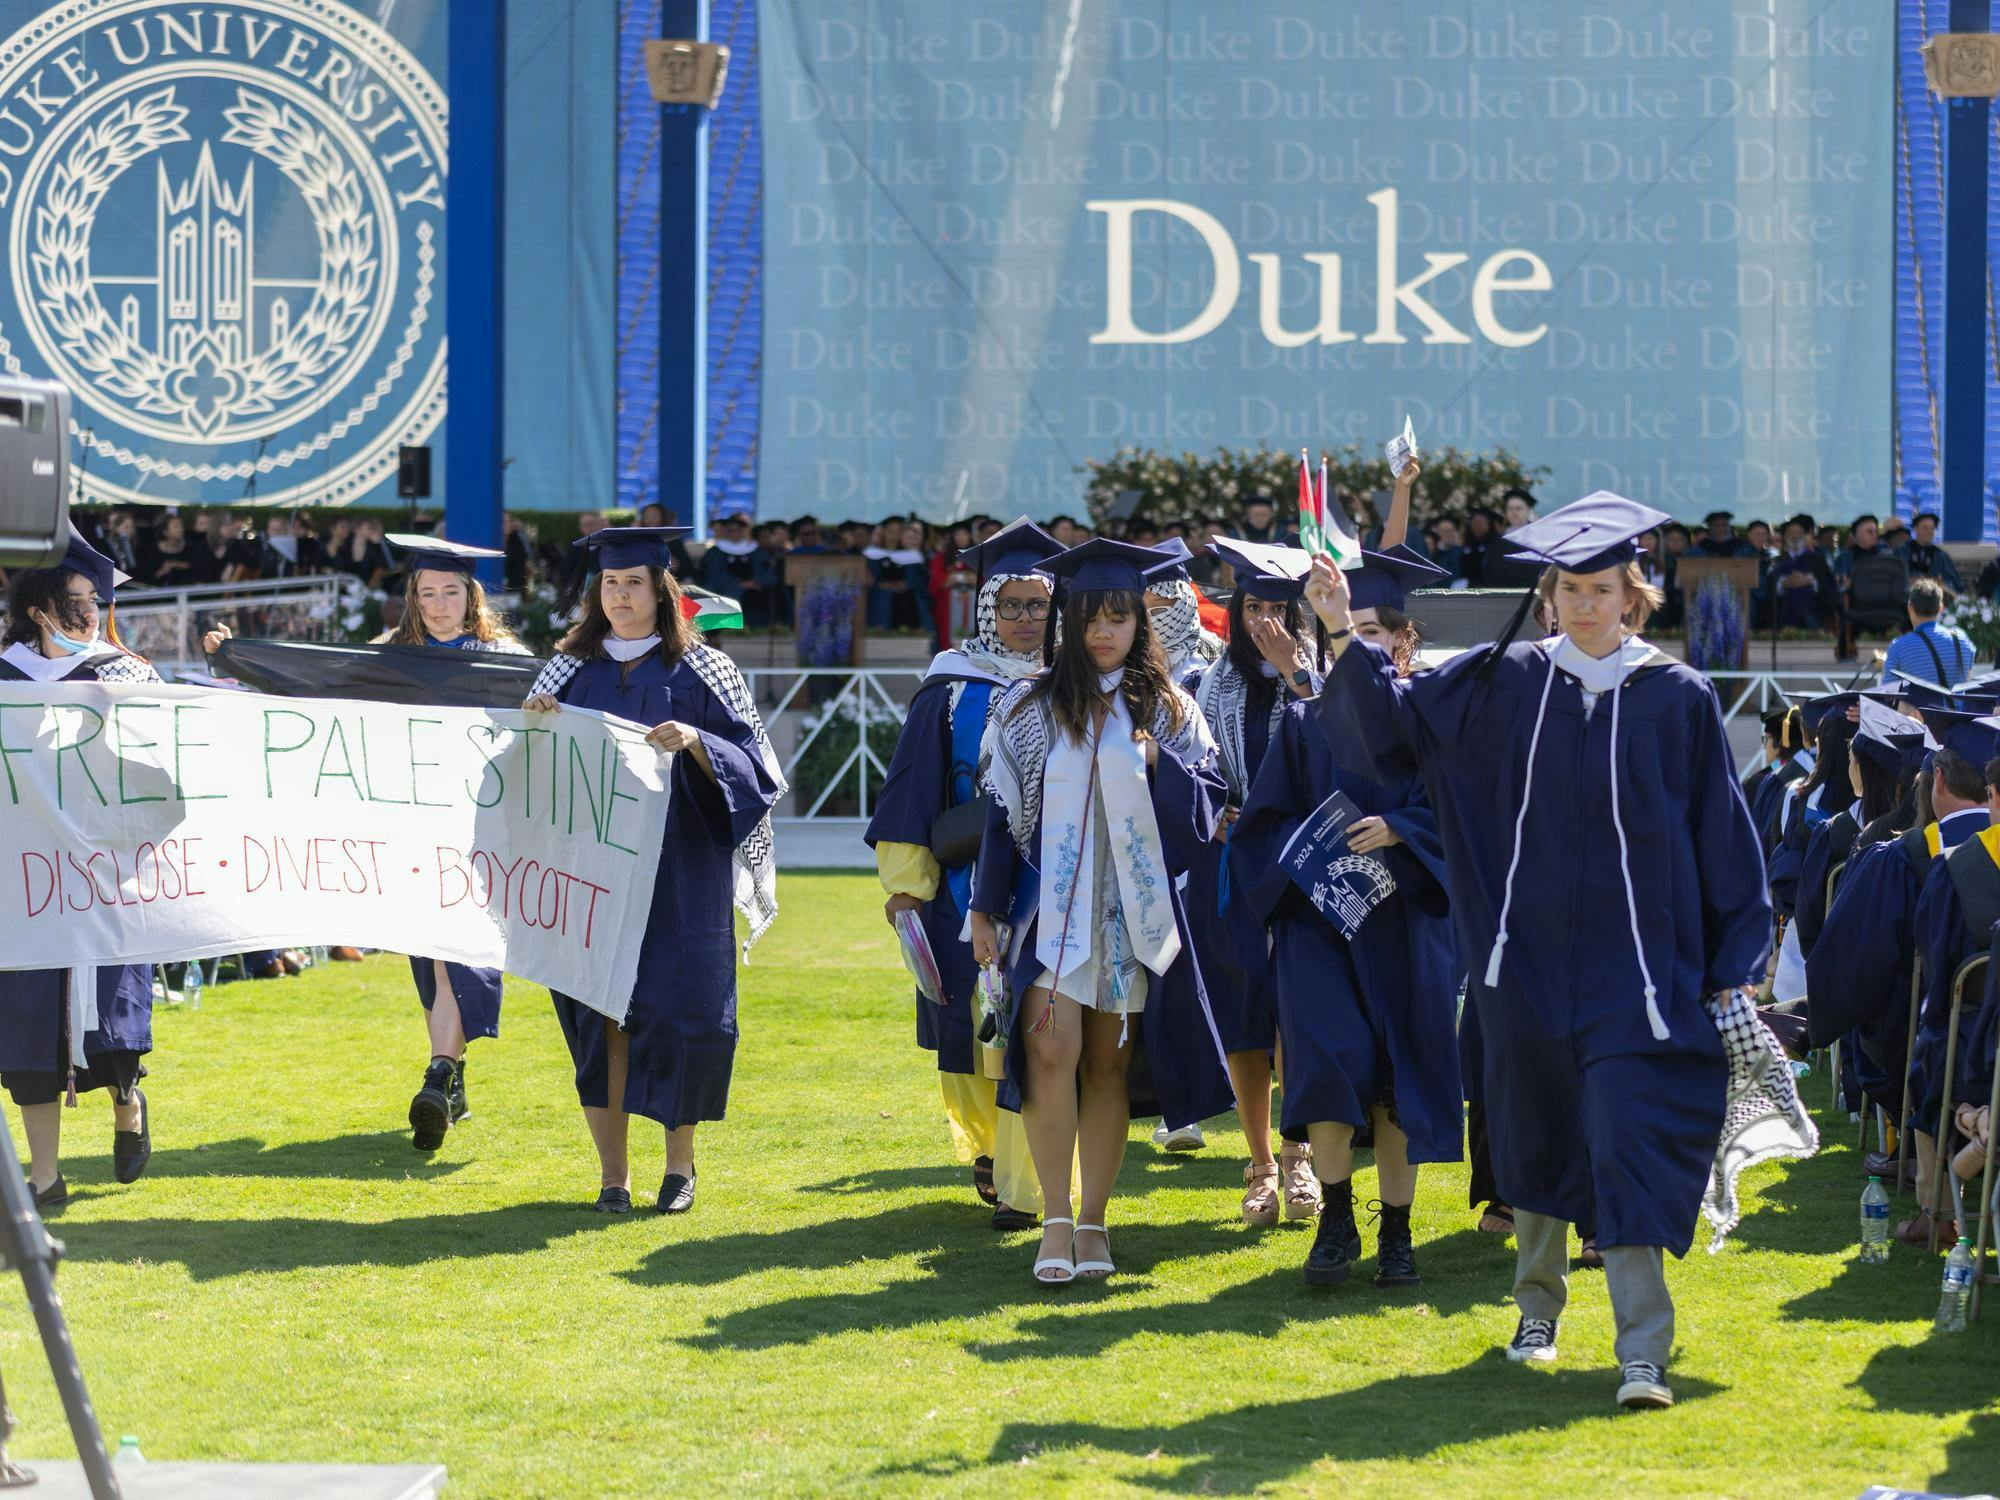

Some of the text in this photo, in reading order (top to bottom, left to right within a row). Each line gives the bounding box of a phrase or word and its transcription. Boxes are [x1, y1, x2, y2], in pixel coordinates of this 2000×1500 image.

[816, 17, 947, 62] Duke
[1119, 16, 1250, 61] Duke
[1271, 15, 1404, 60] Duke
[1425, 14, 1558, 59] Duke
[1580, 14, 1712, 59] Duke
[1733, 13, 1869, 58] Duke
[104, 9, 447, 211] UNIVERSITY
[786, 77, 914, 124] Duke
[1085, 76, 1218, 122] Duke
[1238, 75, 1371, 122] Duke
[1392, 74, 1523, 121] Duke
[1544, 74, 1678, 120] Duke
[1698, 73, 1834, 119] Duke
[816, 137, 1869, 186] Duke Duke Duke Duke Duke Duke Duke
[786, 203, 914, 247] Duke
[933, 202, 1064, 247] Duke
[1238, 201, 1371, 246] Duke
[1544, 200, 1678, 245] Duke
[1698, 199, 1834, 244] Duke
[816, 264, 947, 310] Duke
[967, 264, 1099, 310] Duke
[1580, 263, 1712, 309] Duke
[1733, 263, 1869, 309] Duke
[1085, 187, 1553, 348] Duke
[786, 325, 914, 371] Duke
[933, 325, 1064, 371] Duke
[1544, 324, 1678, 371] Duke
[1698, 324, 1834, 371] Duke
[785, 394, 914, 439] Duke
[933, 394, 1064, 439] Duke
[1085, 393, 1218, 439] Duke
[1238, 393, 1371, 439] Duke
[1544, 392, 1678, 440] Duke
[1698, 392, 1834, 440] Duke
[813, 456, 944, 503] Duke
[1733, 455, 1867, 503] Duke
[0, 702, 654, 855] FREE PALESTINE
[1293, 842, 1314, 870] 2024
[22, 836, 610, 949] DISCLOSE DIVEST BOYCOTT
